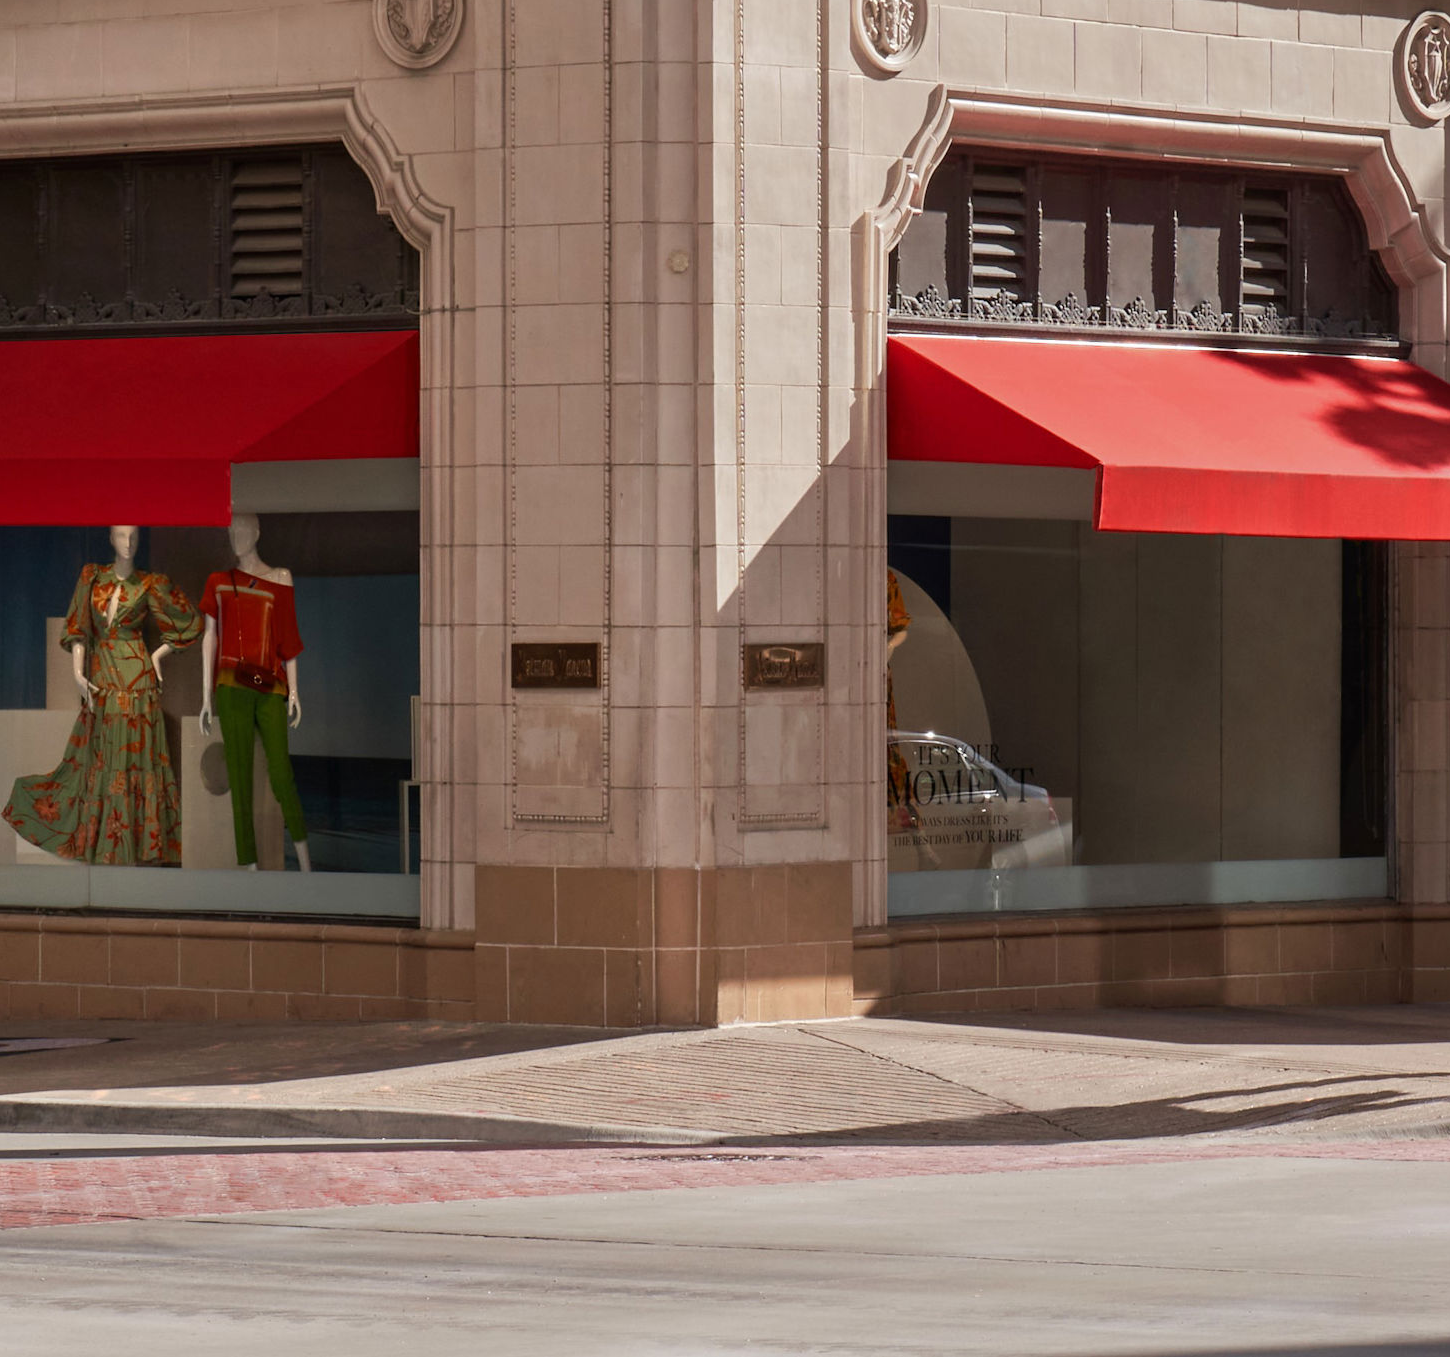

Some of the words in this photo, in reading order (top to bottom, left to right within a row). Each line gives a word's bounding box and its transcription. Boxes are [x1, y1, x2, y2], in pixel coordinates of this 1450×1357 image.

[887, 767, 1035, 807] MOMENT
[943, 816, 970, 827] DRESS
[971, 815, 991, 826] LIKE
[913, 834, 933, 846] BEST
[934, 834, 951, 845] DAY
[965, 829, 996, 843] YOUR
